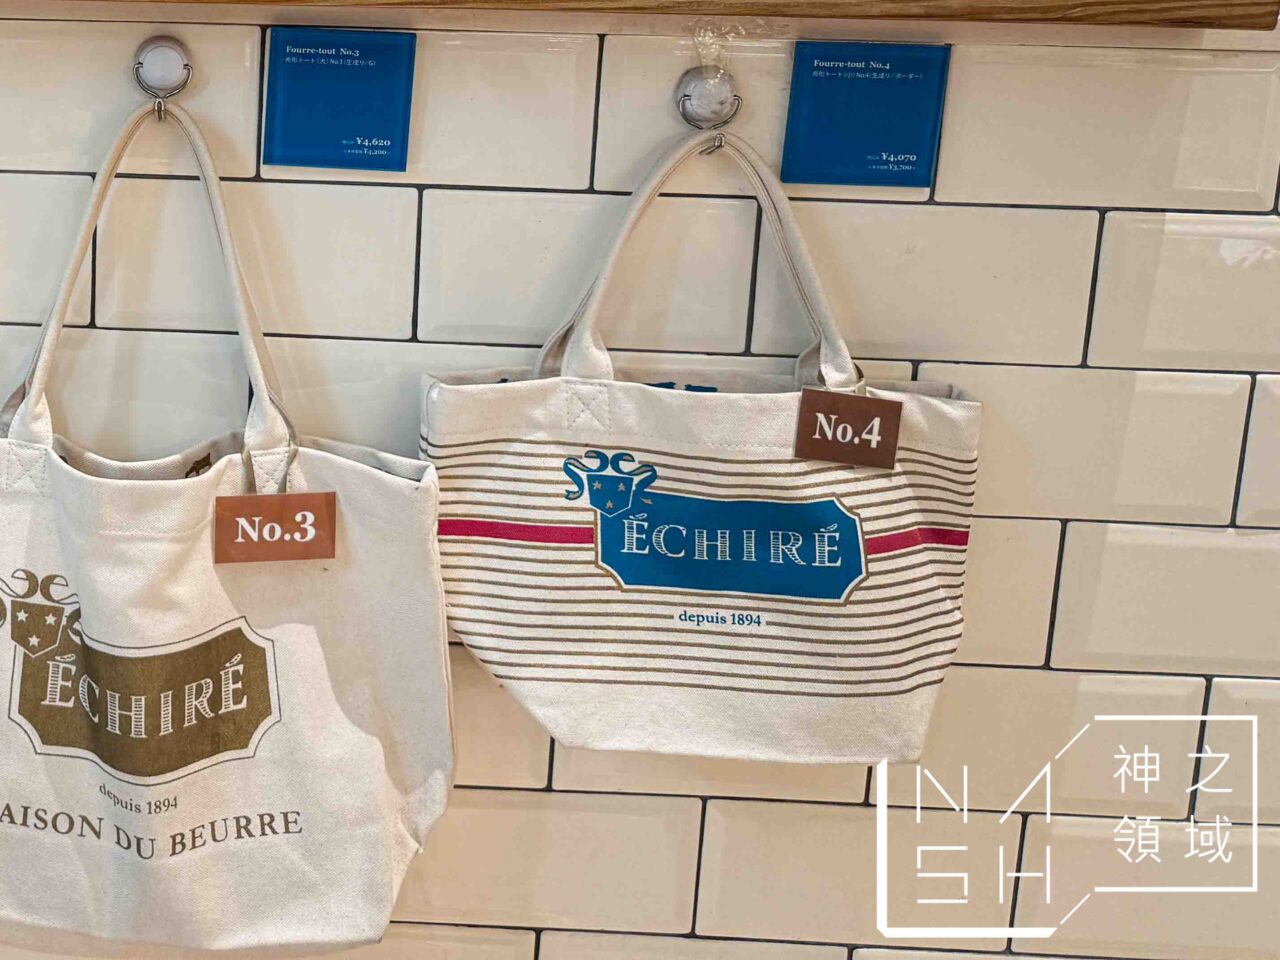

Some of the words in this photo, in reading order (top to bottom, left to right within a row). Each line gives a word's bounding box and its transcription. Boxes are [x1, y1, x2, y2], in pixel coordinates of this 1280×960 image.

[285, 45, 336, 56] Fourre-tout
[339, 47, 360, 57] No.3
[813, 58, 866, 69] Fourre-tout
[355, 136, 391, 147] ¥4,620
[881, 152, 918, 162] ¥4,070
[812, 412, 883, 450] No.4
[233, 511, 316, 543] No.3
[620, 512, 842, 568] ÉCHIRÉ
[678, 609, 727, 627] depuis
[730, 610, 763, 626] 1894
[40, 652, 247, 738] ÉCHIRÉ
[98, 783, 143, 815] depuis
[146, 795, 179, 816] 1894
[114, 823, 158, 861] DU
[169, 810, 304, 858] BEURRE
